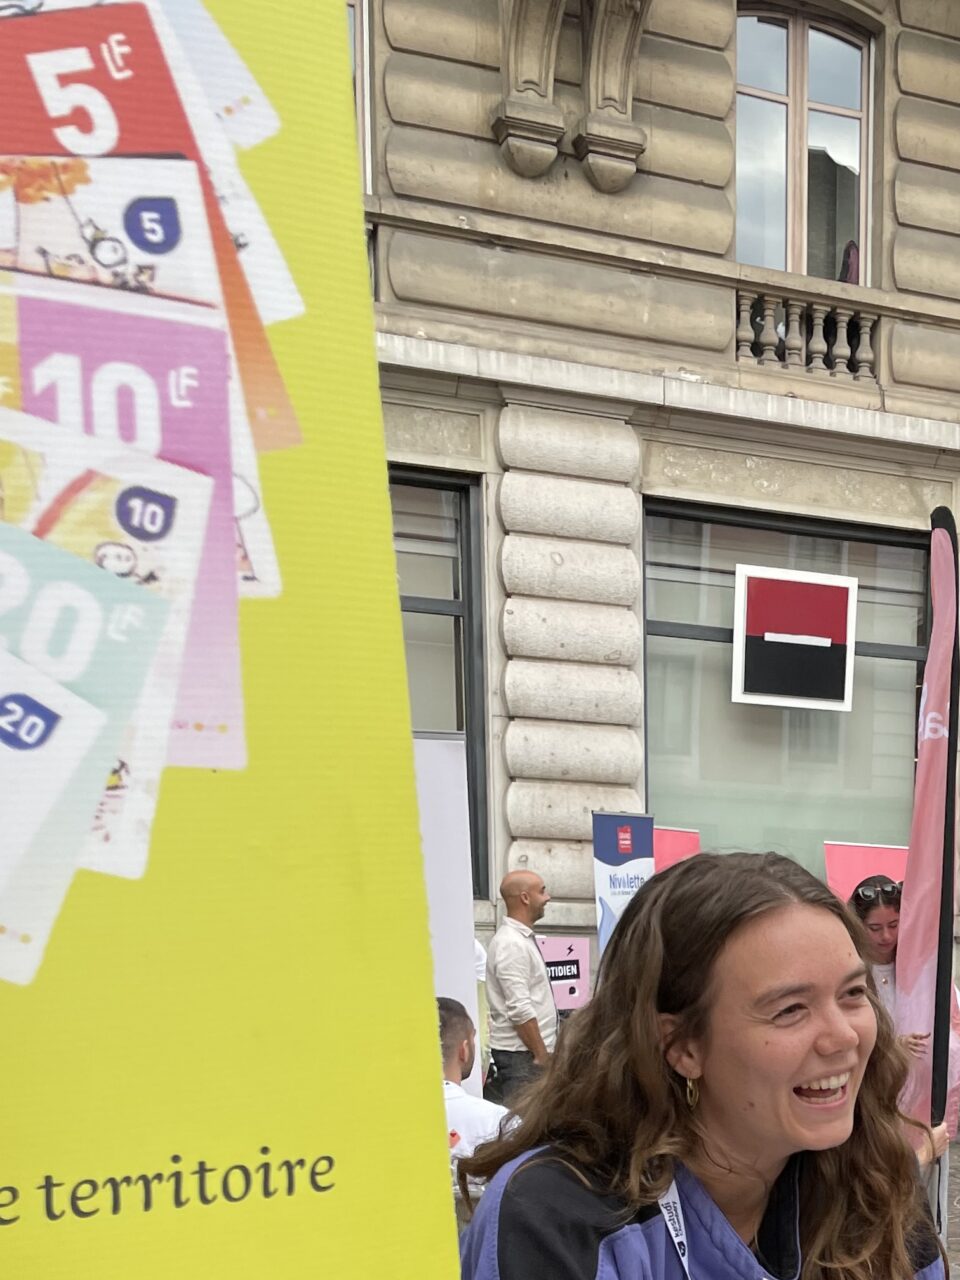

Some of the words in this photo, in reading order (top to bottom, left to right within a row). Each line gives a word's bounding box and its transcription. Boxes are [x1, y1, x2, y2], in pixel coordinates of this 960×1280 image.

[26, 47, 119, 156] 5
[140, 211, 165, 244] 5
[32, 353, 162, 456] 10
[128, 498, 164, 534] 10
[0, 701, 45, 745] 20
[37, 1146, 336, 1221] territoire
